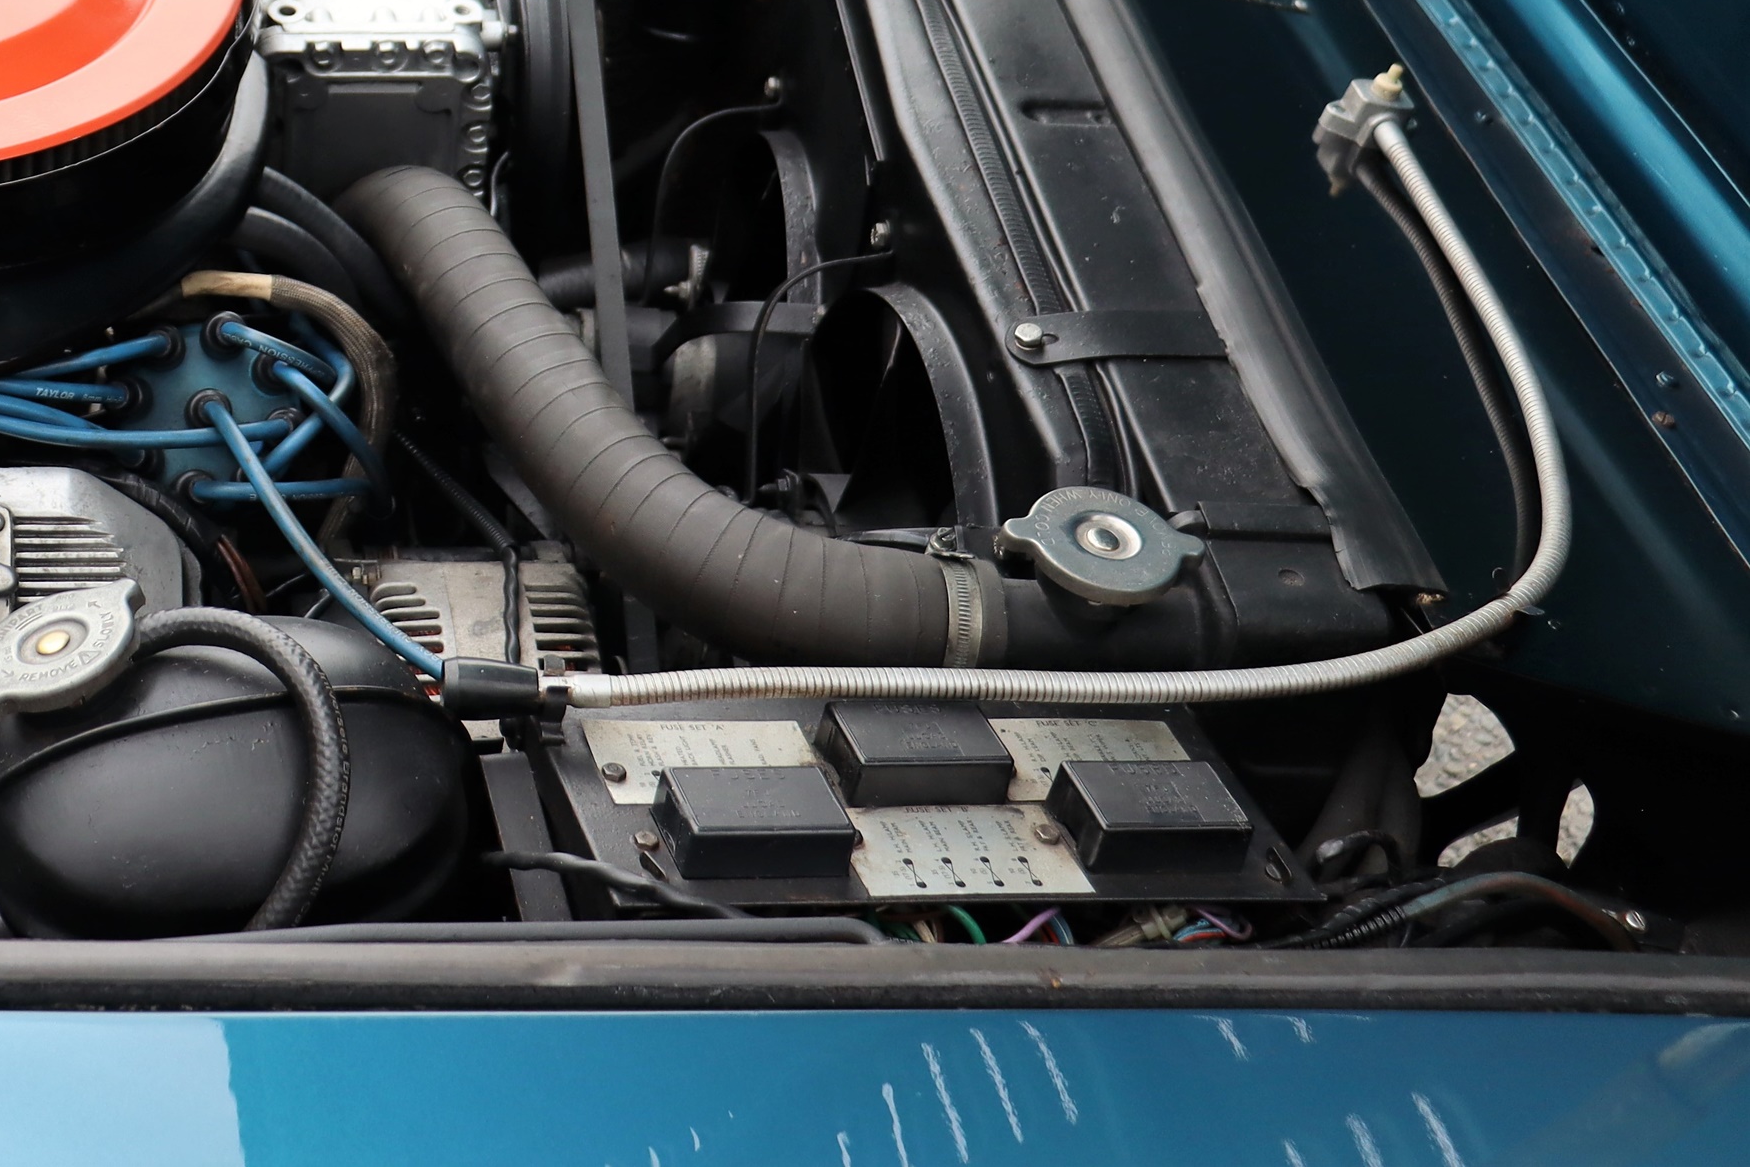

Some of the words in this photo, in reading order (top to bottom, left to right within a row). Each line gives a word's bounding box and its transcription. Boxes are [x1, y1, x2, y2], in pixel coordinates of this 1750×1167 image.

[35, 387, 75, 400] TAYLOR
[1040, 489, 1082, 513] WHEN
[18, 659, 78, 683] REMOVE
[659, 722, 684, 731] FUSE
[688, 723, 707, 731] SET
[904, 806, 930, 814] FUSE
